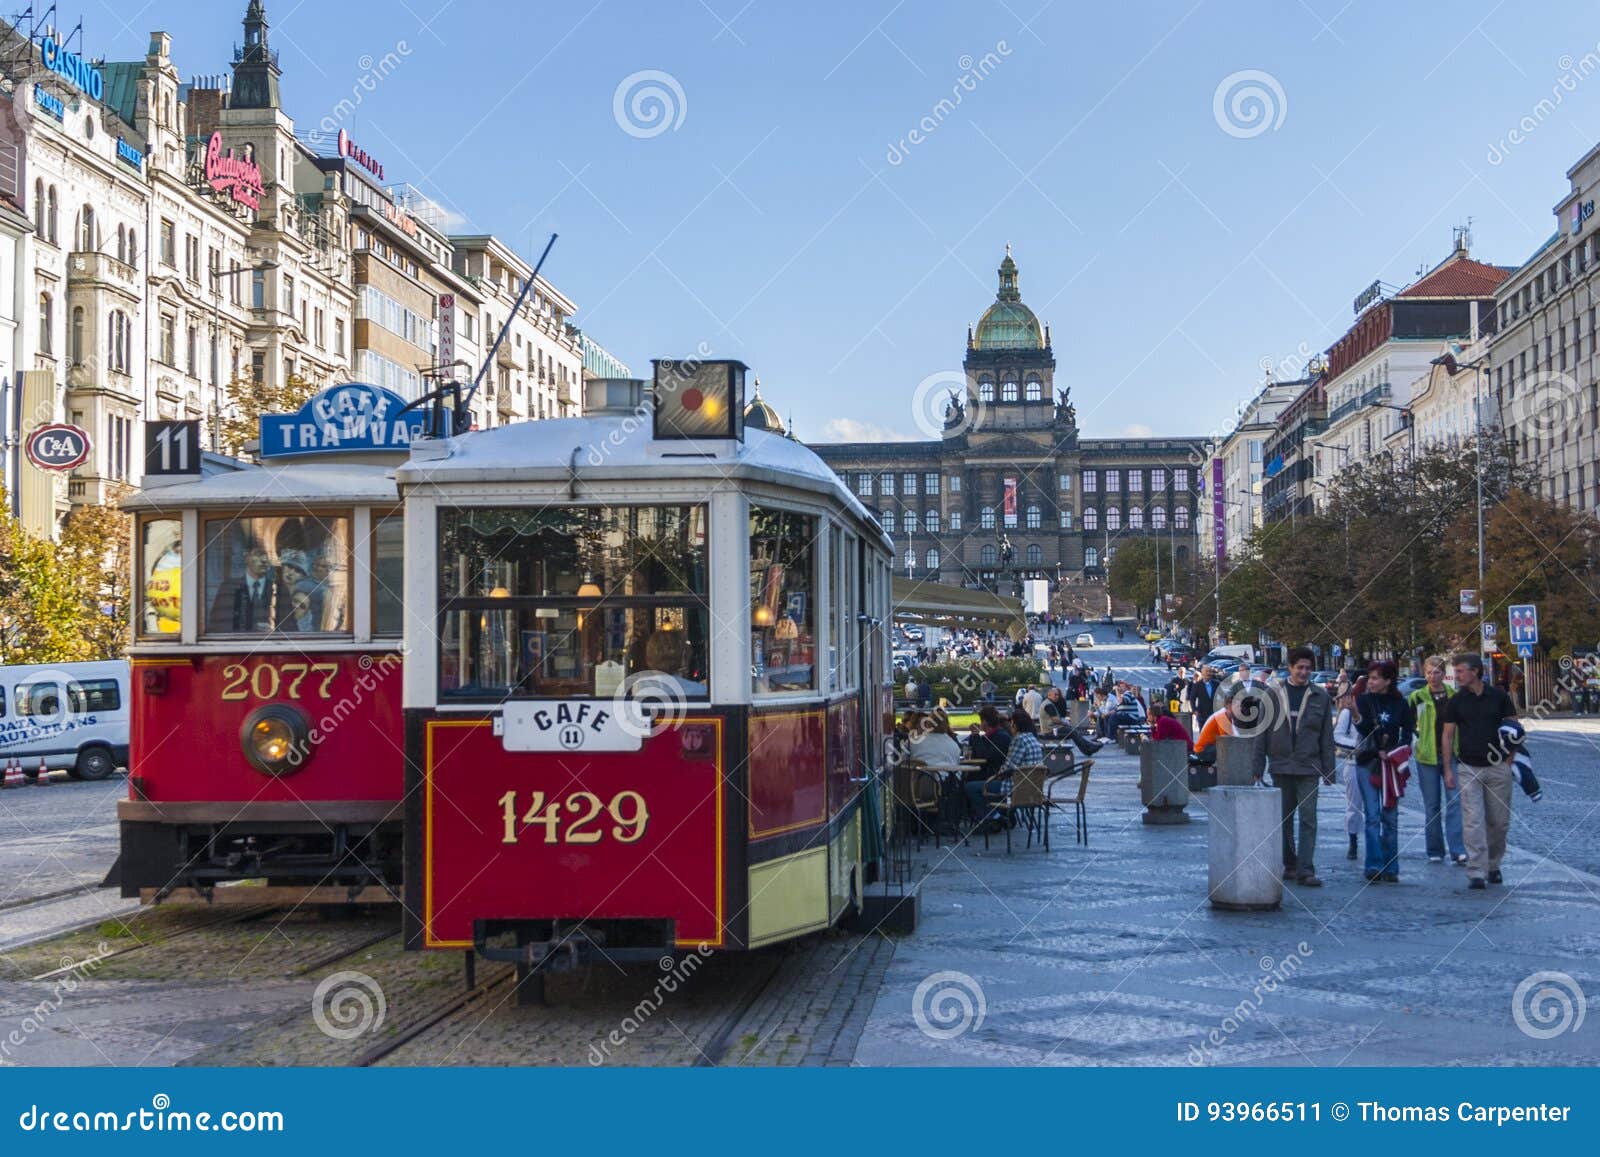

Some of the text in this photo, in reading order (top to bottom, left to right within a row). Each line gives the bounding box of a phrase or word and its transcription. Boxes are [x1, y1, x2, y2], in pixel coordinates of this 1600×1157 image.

[42, 36, 103, 101] CASINO
[347, 139, 384, 181] RAMADA
[442, 314, 451, 378] RAMADA
[315, 391, 391, 421] CAFE
[38, 436, 78, 457] C&A
[156, 425, 188, 470] 11
[279, 415, 426, 448] TRAMVA
[221, 663, 339, 700] 2077
[533, 702, 610, 733] CAFE
[564, 730, 580, 744] 11
[498, 790, 649, 844] 1429
